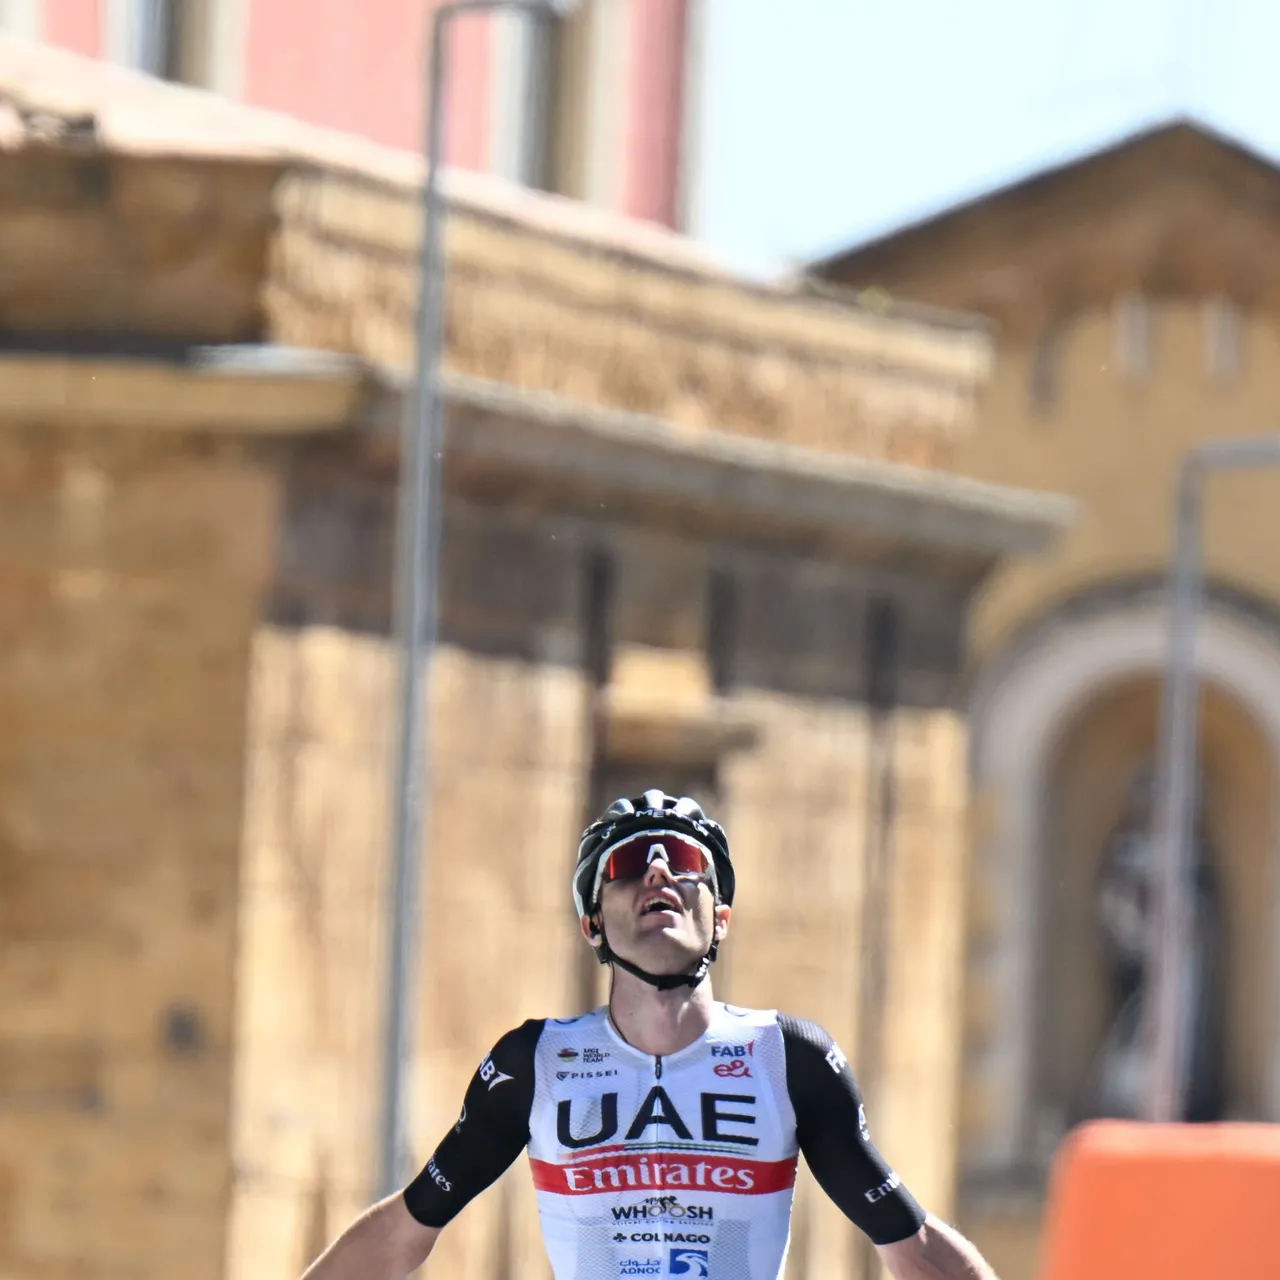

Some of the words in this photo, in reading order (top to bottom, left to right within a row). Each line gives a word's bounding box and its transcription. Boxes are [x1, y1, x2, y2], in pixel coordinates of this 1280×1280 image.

[711, 1045, 746, 1057] FAB
[571, 1069, 618, 1079] PISSEI
[557, 1085, 759, 1149] UAE
[563, 1157, 755, 1192] Emirates
[611, 1204, 713, 1220] WHOOSH
[630, 1232, 711, 1244] COLNAGO
